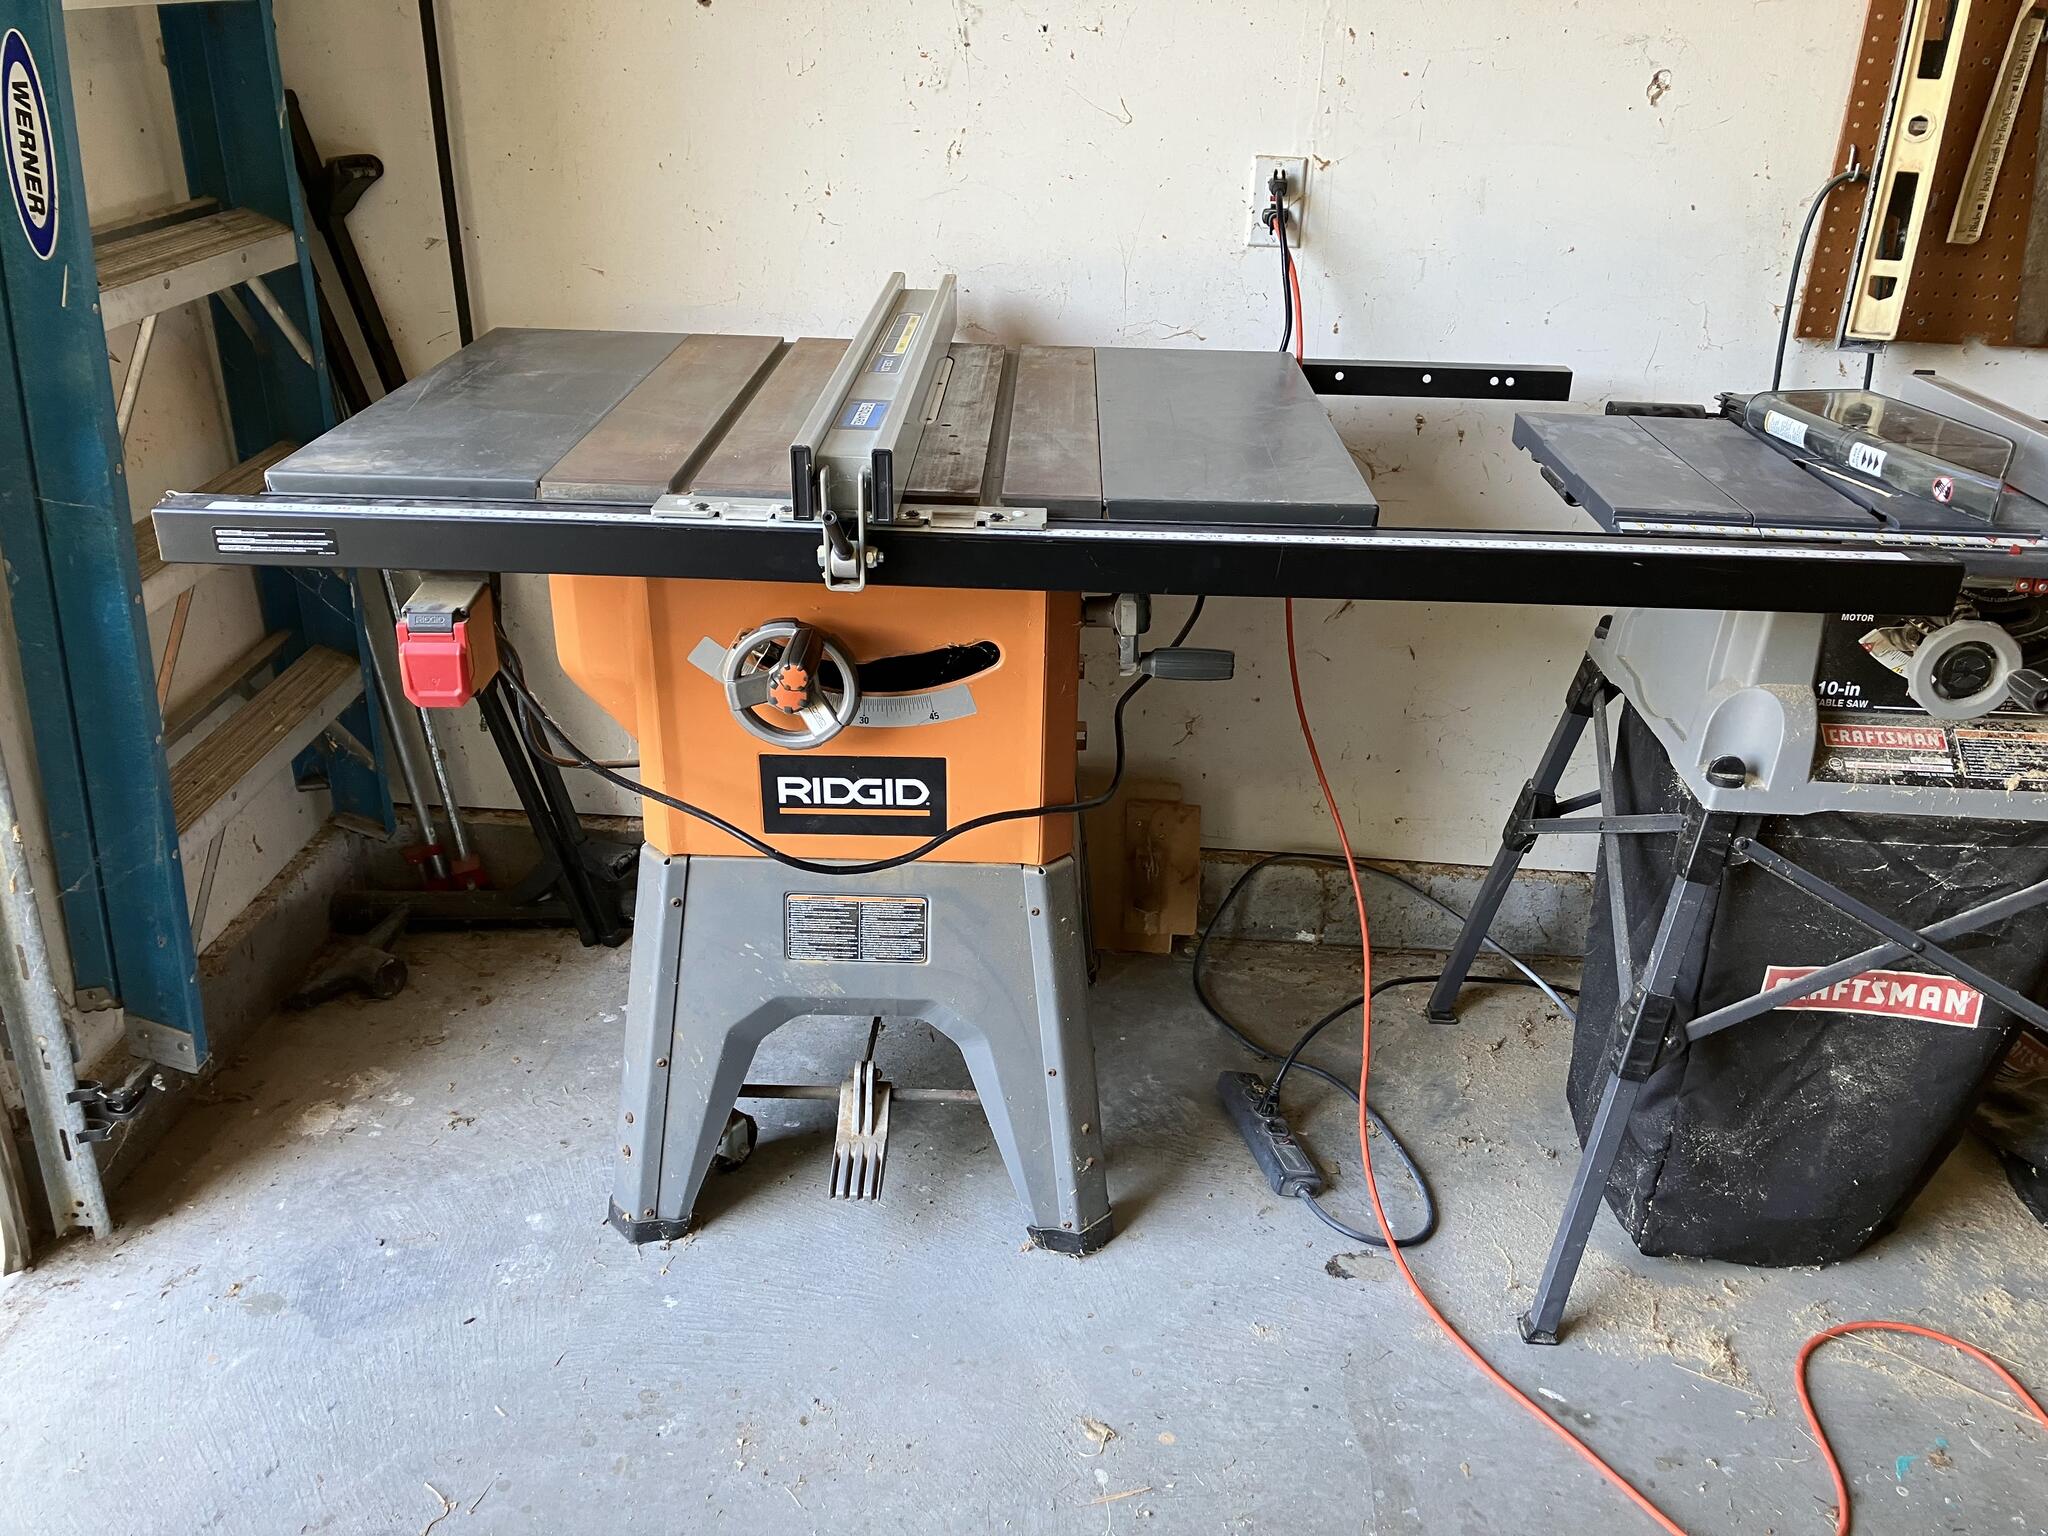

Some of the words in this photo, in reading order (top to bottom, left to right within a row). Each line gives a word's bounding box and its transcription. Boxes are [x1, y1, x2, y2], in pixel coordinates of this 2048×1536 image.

[2012, 64, 2027, 82] Made
[11, 81, 46, 218] WERNER
[1841, 613, 1874, 622] MOTOR
[1818, 680, 1860, 696] 10-in
[1816, 698, 1844, 707] ABLE
[1846, 699, 1869, 708] SAW
[859, 716, 869, 725] 30
[929, 712, 940, 722] 45
[1828, 729, 1941, 746] CRAFTSMAN
[777, 776, 930, 806] RIDGID
[1775, 977, 1968, 1016] FTSMAN
